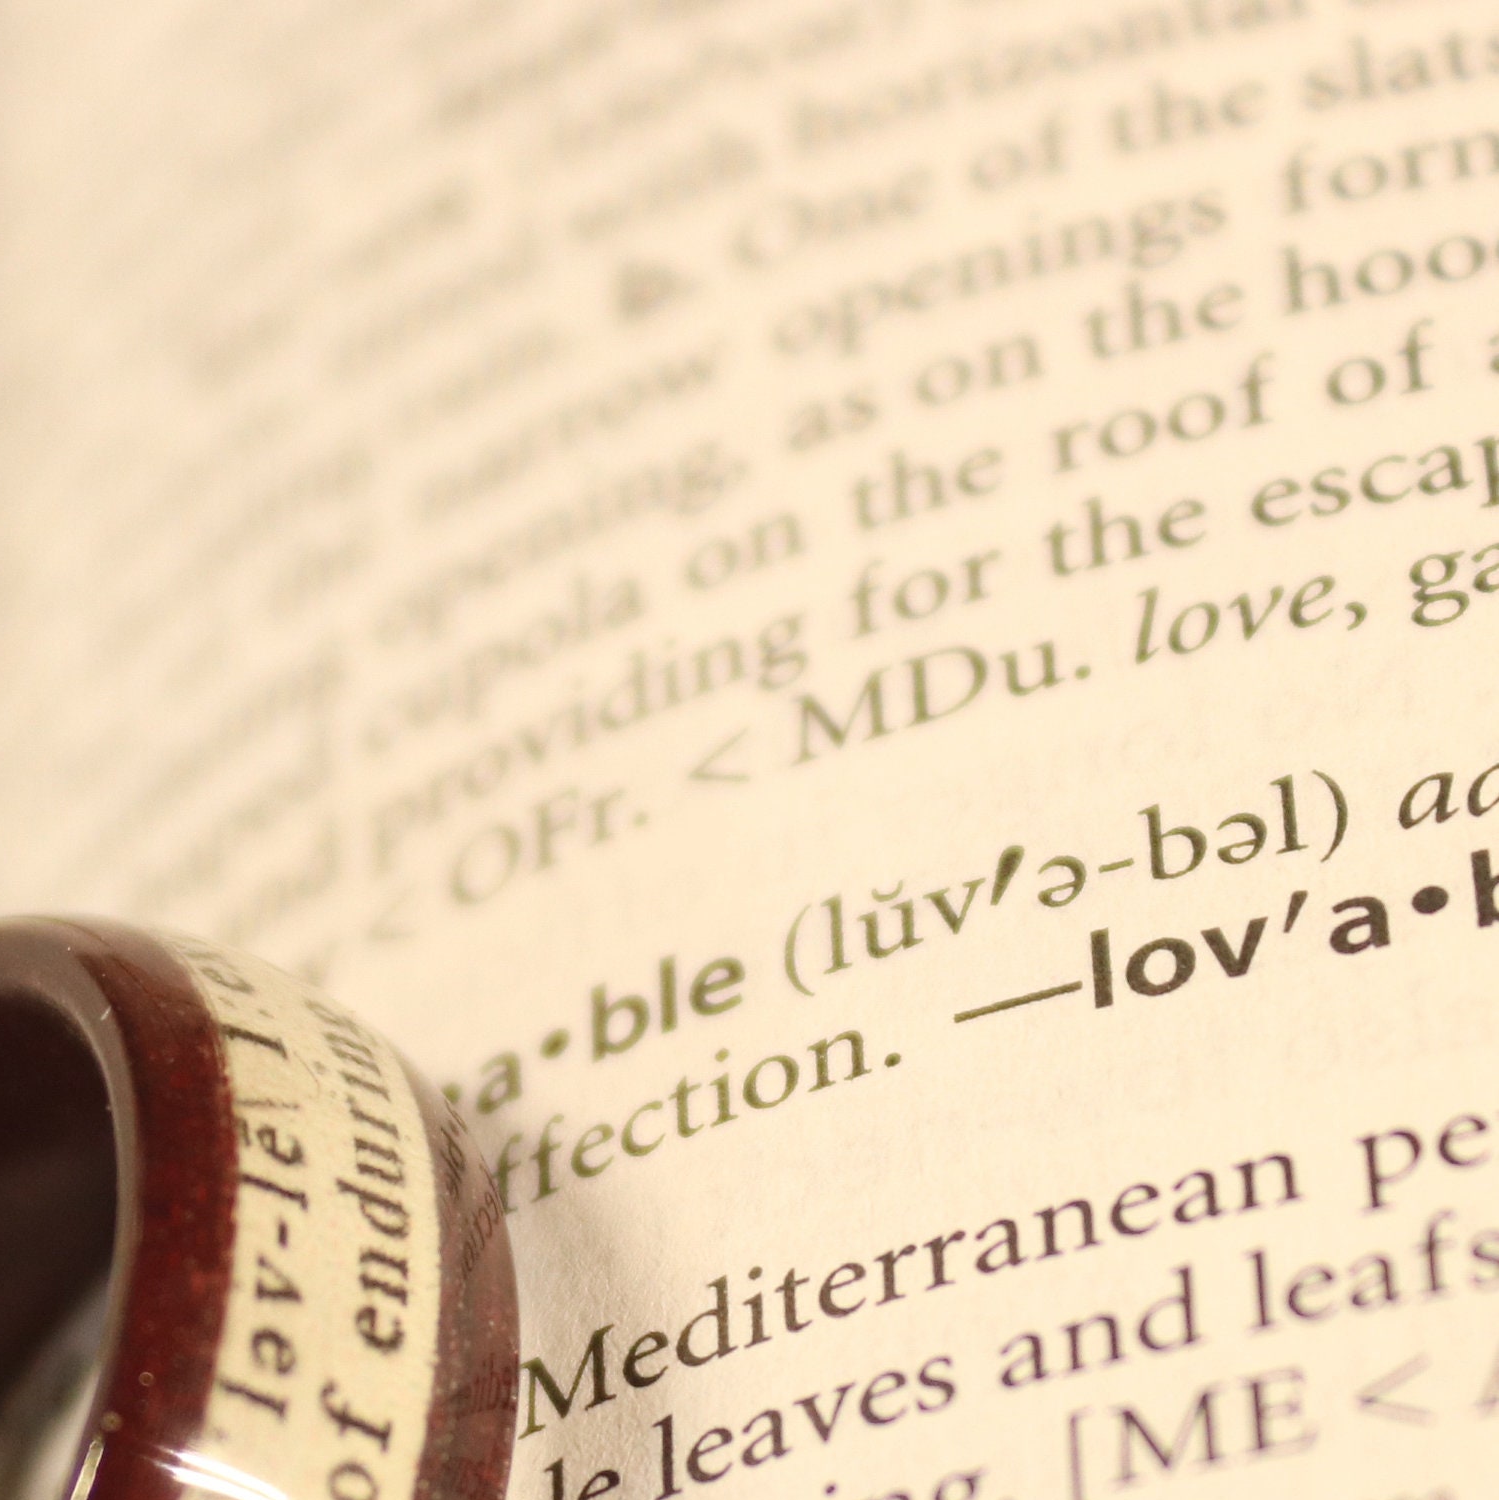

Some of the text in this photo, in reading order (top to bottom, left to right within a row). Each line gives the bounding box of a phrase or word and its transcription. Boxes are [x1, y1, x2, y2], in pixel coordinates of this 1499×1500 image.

[967, 120, 1070, 197] of
[1104, 73, 1270, 160] the
[782, 232, 1499, 456] as on the hoo
[679, 507, 808, 592] on
[848, 442, 1005, 540] the
[1048, 350, 1277, 480] roof
[1322, 318, 1437, 408] of
[850, 542, 1003, 640] for
[1044, 496, 1209, 585] the
[450, 790, 649, 908] OFr.
[793, 643, 1092, 766] MDu.
[1135, 573, 1368, 665] love,
[494, 1028, 903, 1218] ffection.
[519, 1144, 1302, 1440] Mediterranean
[998, 1265, 1206, 1392] and
